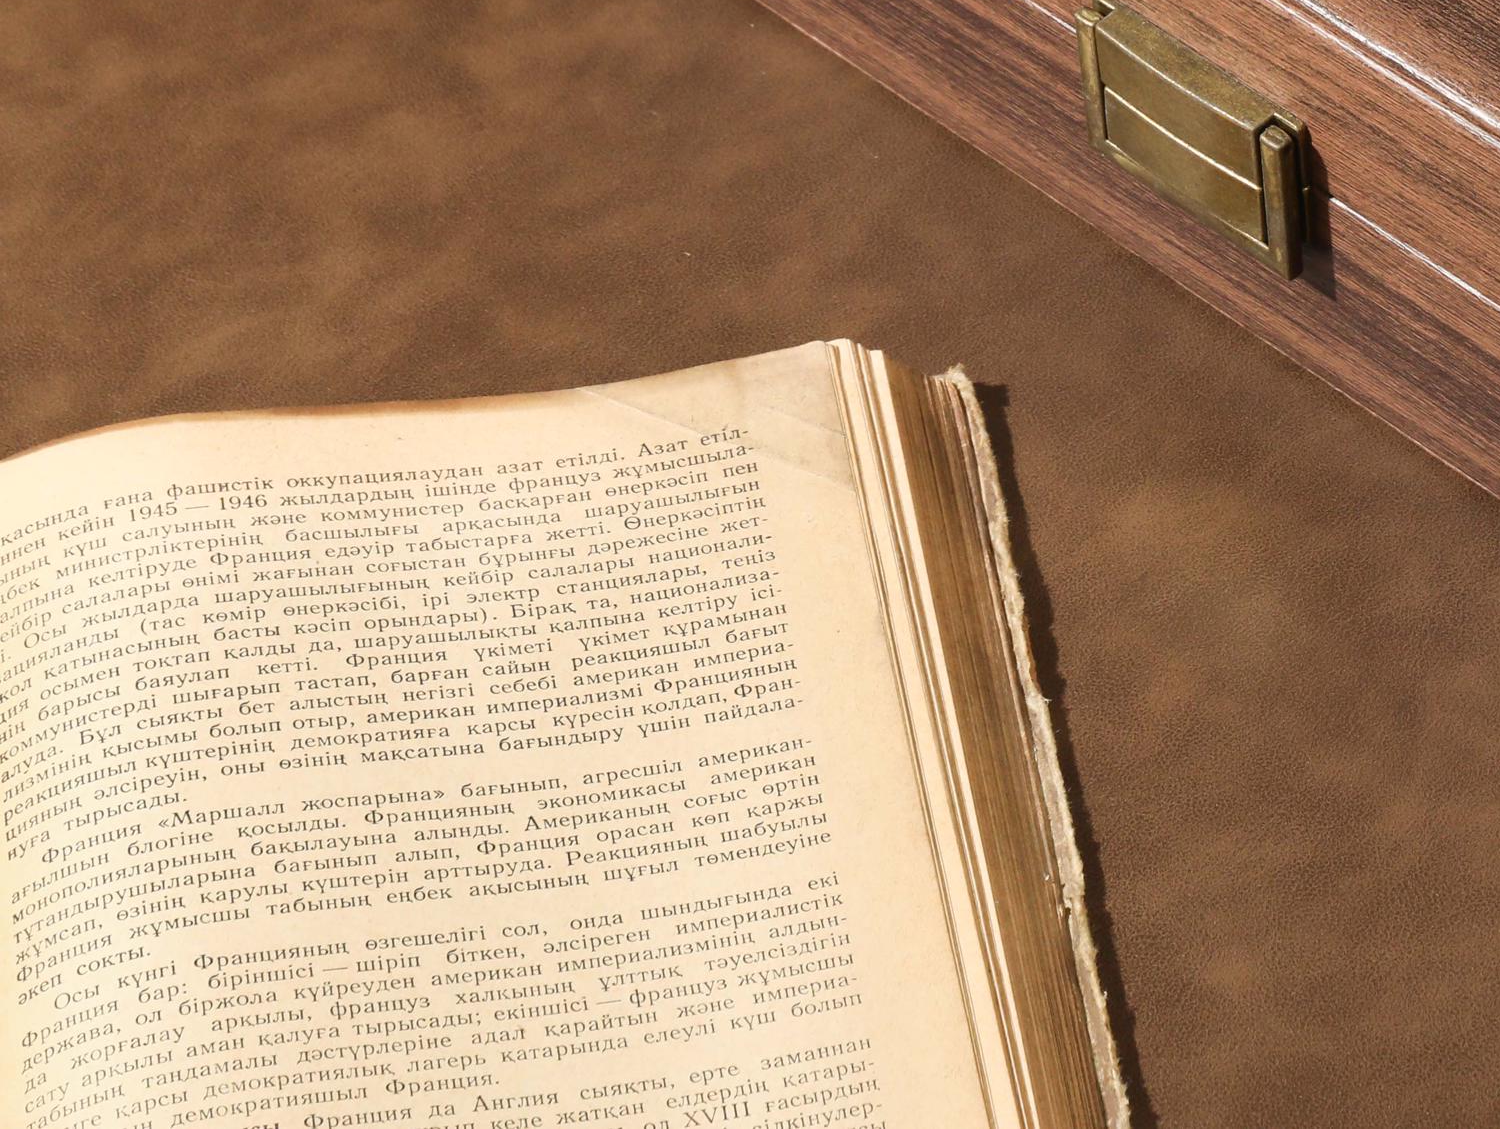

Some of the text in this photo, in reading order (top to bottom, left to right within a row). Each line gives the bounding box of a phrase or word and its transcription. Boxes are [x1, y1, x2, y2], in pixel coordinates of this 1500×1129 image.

[219, 488, 415, 512] 1946 жылдардың
[285, 465, 483, 491] оккупациялаудан
[583, 479, 761, 520] шаруашылығын
[721, 461, 759, 479] пен
[181, 546, 576, 589] өнімі жағынан бұрынғы
[209, 495, 767, 570] Франция Өнеркәсіптің
[213, 533, 773, 606] шаруашылығының кейбір национали-
[43, 569, 780, 681] қатынасының басты кәсіп орындары). Бірақ та, национализа-
[131, 583, 783, 673] тоқтап қалды да, шаруашылықты қалпына келтіру ісі-
[139, 563, 707, 636] (тас көмір өнеркәсібі, ірі станциялары,
[133, 603, 787, 692] баяулап кетті. Франция үкіметі үкімет құрамынан
[171, 621, 789, 706] шығарып тастап, барған сайын реакцияшыл бағыт
[79, 641, 795, 747] Бұл сыяқты бет алыстың негізгі себебі американ империа-
[101, 658, 799, 760] қысымы болып отыр, американ империализмі Францияның
[145, 677, 801, 770] күштерінің демократияға күресін қолдап, Фран-
[93, 697, 804, 801] әлсіреуін, оны өзінің мақсатына бағындыру үшін пайдала-
[41, 737, 813, 865] Франция «Маршалл жоспарына» бағынып, агресшіл американ-
[63, 791, 188, 832] тырысады.
[127, 754, 817, 857] блогіне қосылды. Францияның экономикасы американ
[11, 772, 821, 926] монополияларының бақылауына алынды. Американың соғыс өртін
[13, 792, 823, 945] тұтандырушыларына бағынып алып, Франция орасан көп қаржы
[115, 812, 828, 922] өзінің қарулы күштерін арттыруда. Реакцияның шабуылы
[129, 831, 832, 940] жұмысшы табының еңбек ақысының шұғыл төмендеуіне
[117, 884, 793, 990] күнгі Францияның өзгешелігі сол, онда шындығында
[137, 892, 844, 1004] бар: біріншісі шіріп біткен, әлсіреген империалистік
[177, 930, 757, 1017] біржола американ империализмінің
[185, 978, 729, 1059] аман екіншісі француз
[211, 996, 431, 1035] арқылы, француз
[406, 1036, 629, 1074] лагерь қатарында
[543, 1010, 658, 1039] қарайтын
[303, 1107, 413, 1129] Франция
[471, 1091, 559, 1113] Англия
[385, 1073, 501, 1098] Франция.
